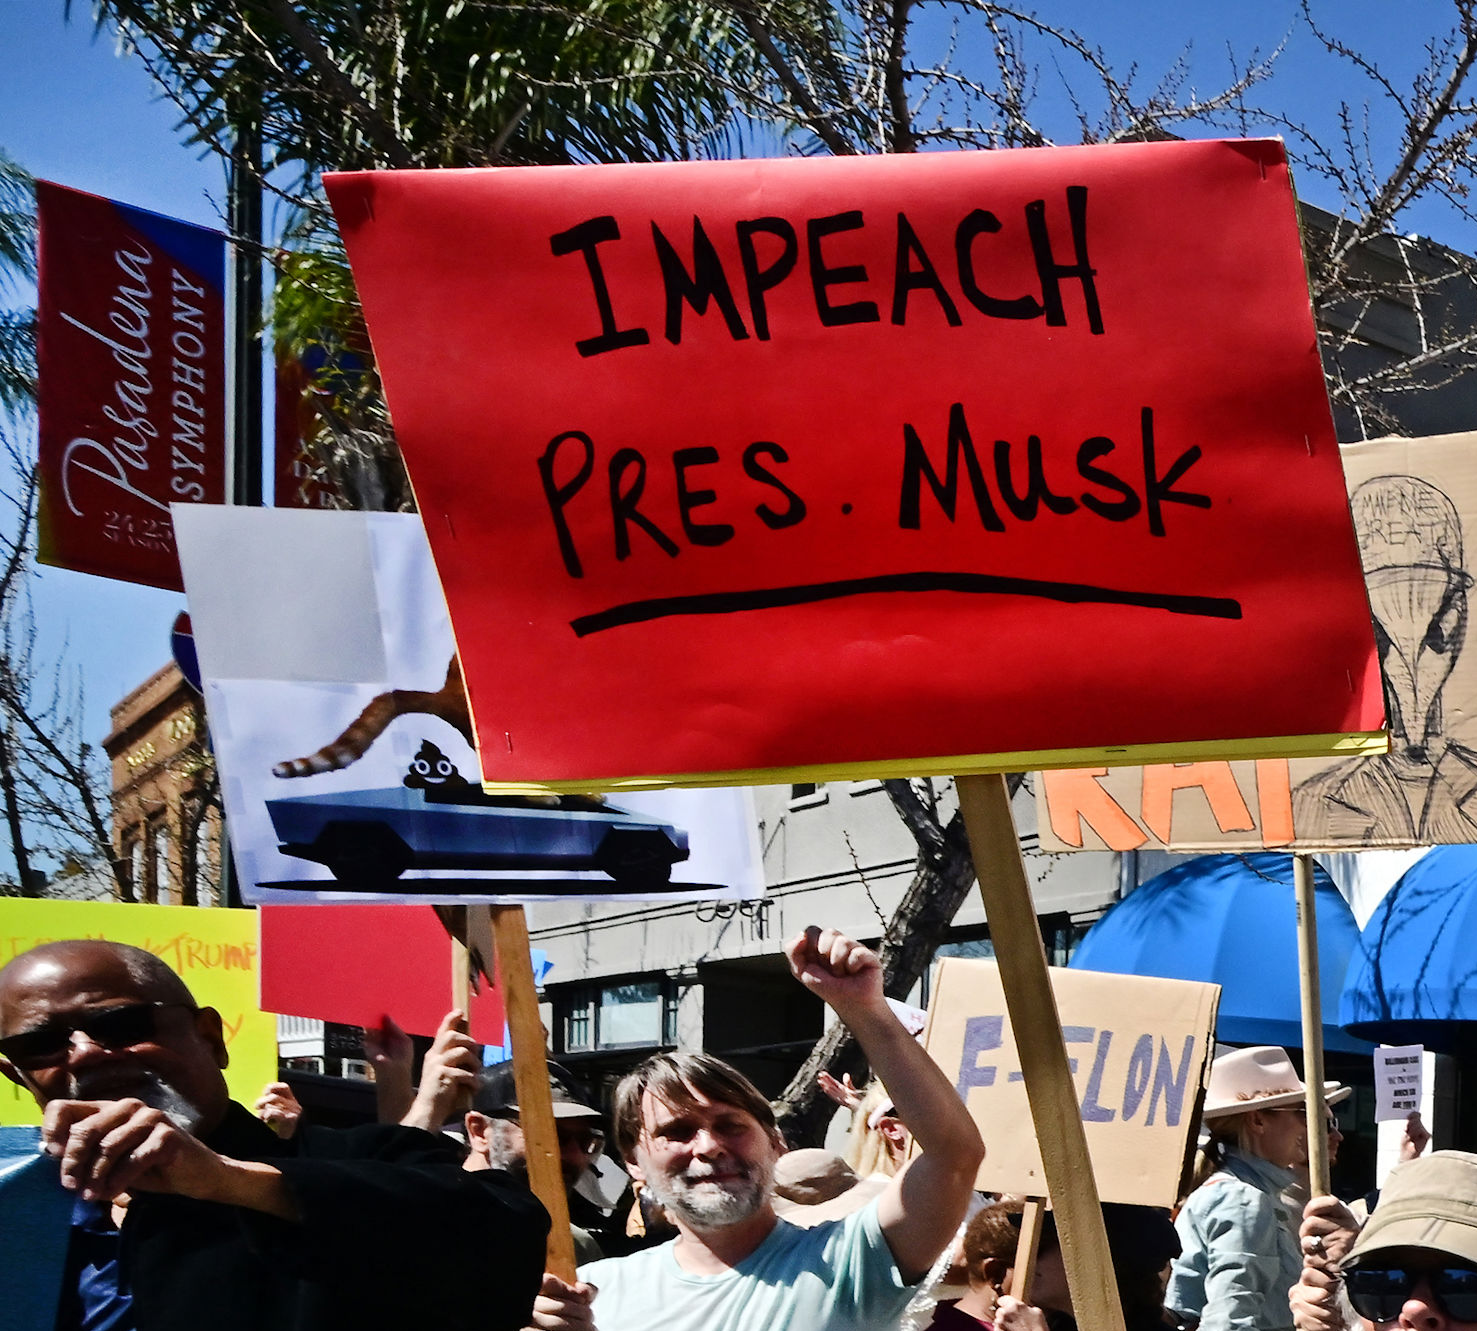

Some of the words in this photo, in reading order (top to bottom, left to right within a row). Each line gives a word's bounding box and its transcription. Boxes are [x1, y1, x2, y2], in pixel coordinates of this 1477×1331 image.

[60, 232, 172, 516] Pasadena
[172, 267, 206, 501] SYMPHONY
[550, 186, 1105, 357] IMPEACH
